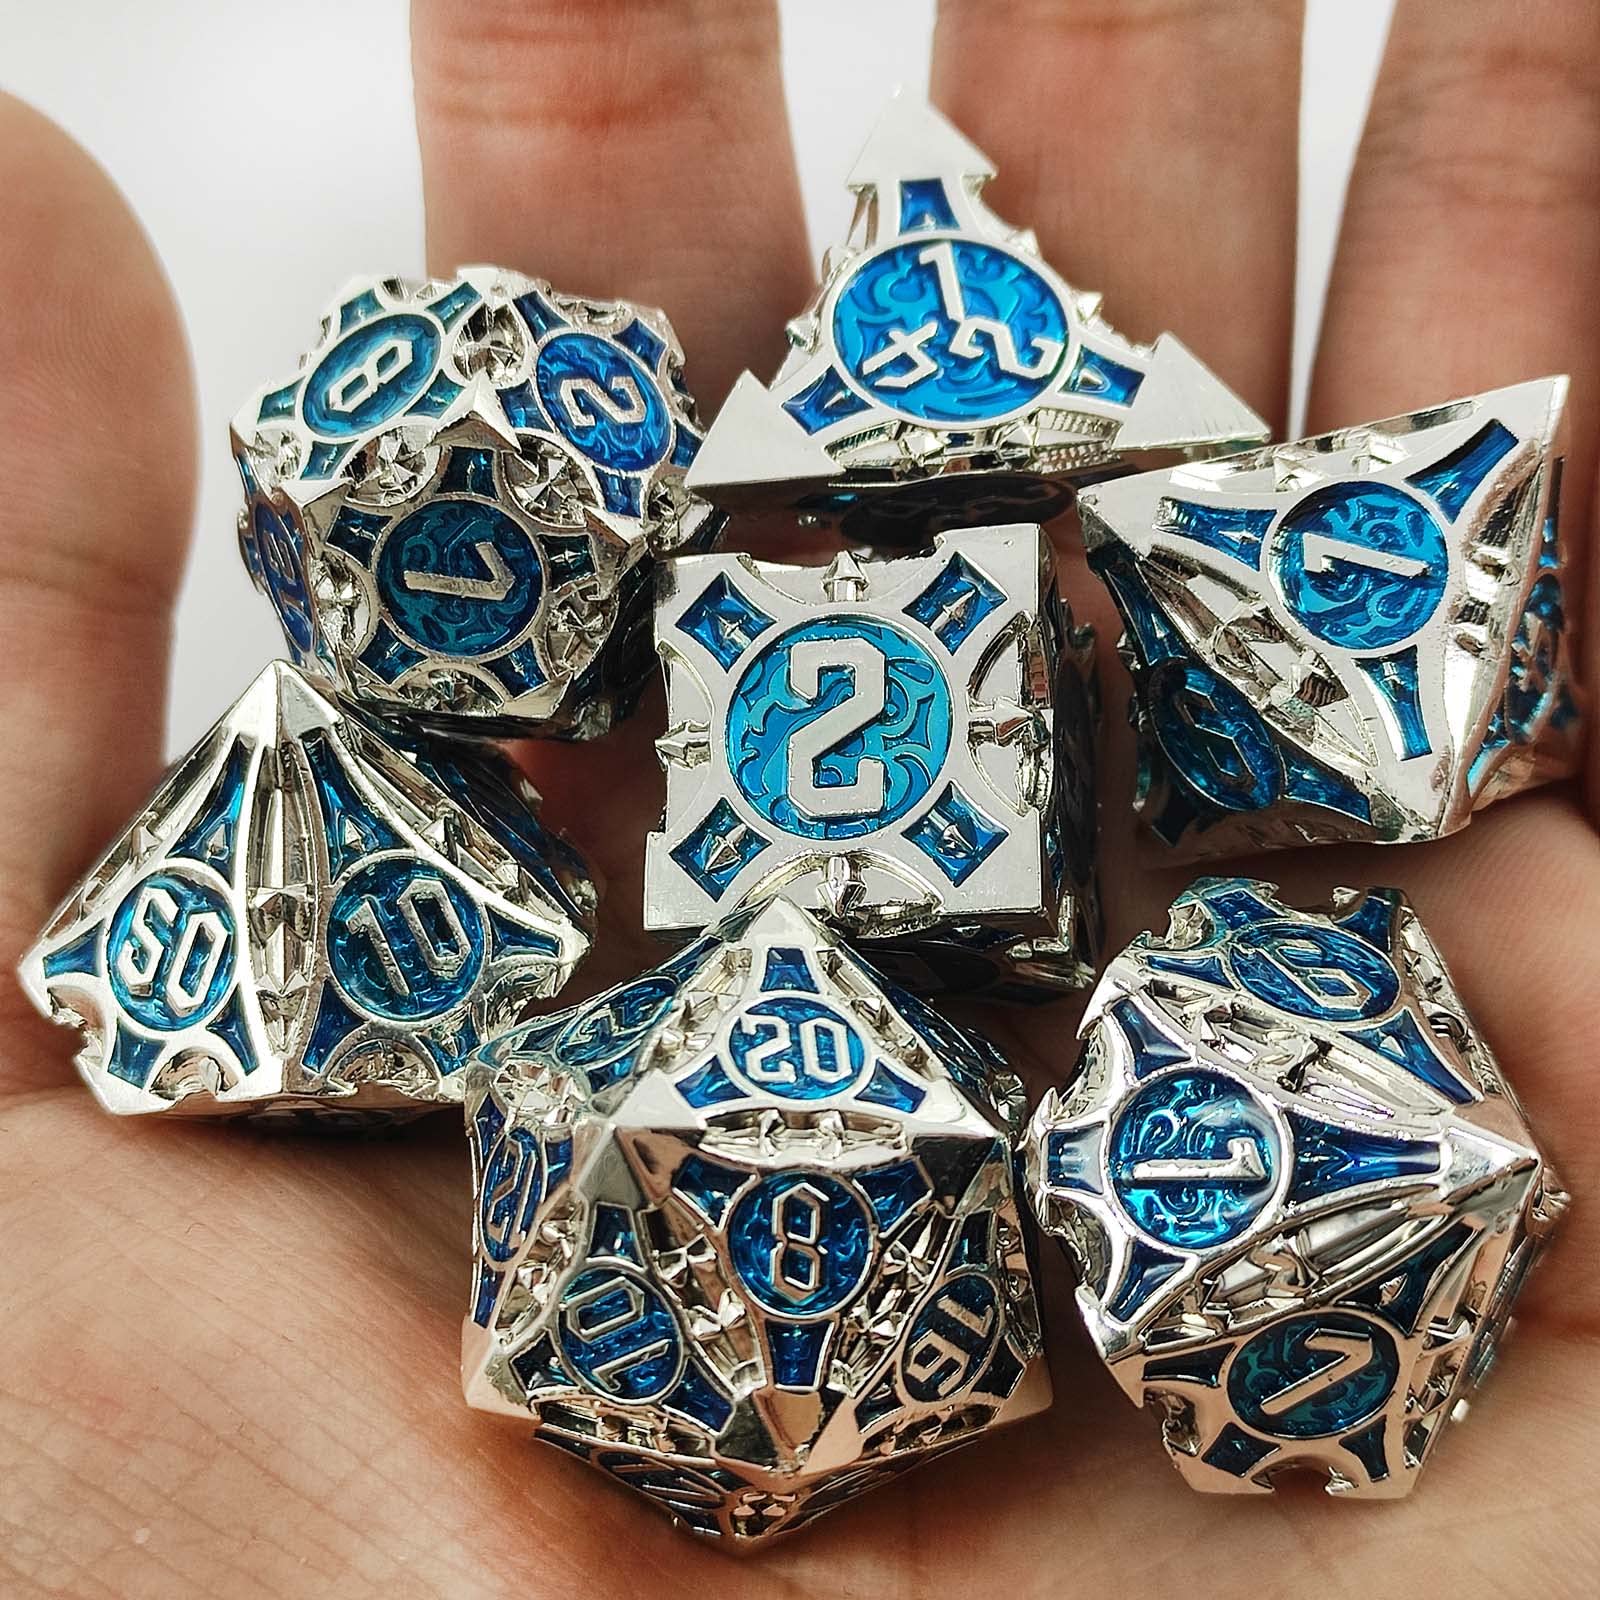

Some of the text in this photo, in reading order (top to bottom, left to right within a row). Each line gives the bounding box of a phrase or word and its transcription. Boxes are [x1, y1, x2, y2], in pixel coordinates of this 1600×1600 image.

[919, 241, 966, 322] 1
[327, 339, 414, 414] 8
[862, 322, 938, 387] 4
[949, 317, 1064, 379] 2
[560, 376, 647, 428] 2
[403, 542, 515, 602] 7
[1303, 532, 1431, 579] 1
[787, 637, 887, 819] 2
[118, 885, 230, 1016] 50
[346, 878, 471, 997] 10
[740, 1013, 853, 1083] 20
[1130, 1136, 1270, 1181] 1
[768, 1181, 825, 1302] 8
[562, 1275, 673, 1392] 10
[1260, 1326, 1374, 1420] 7
